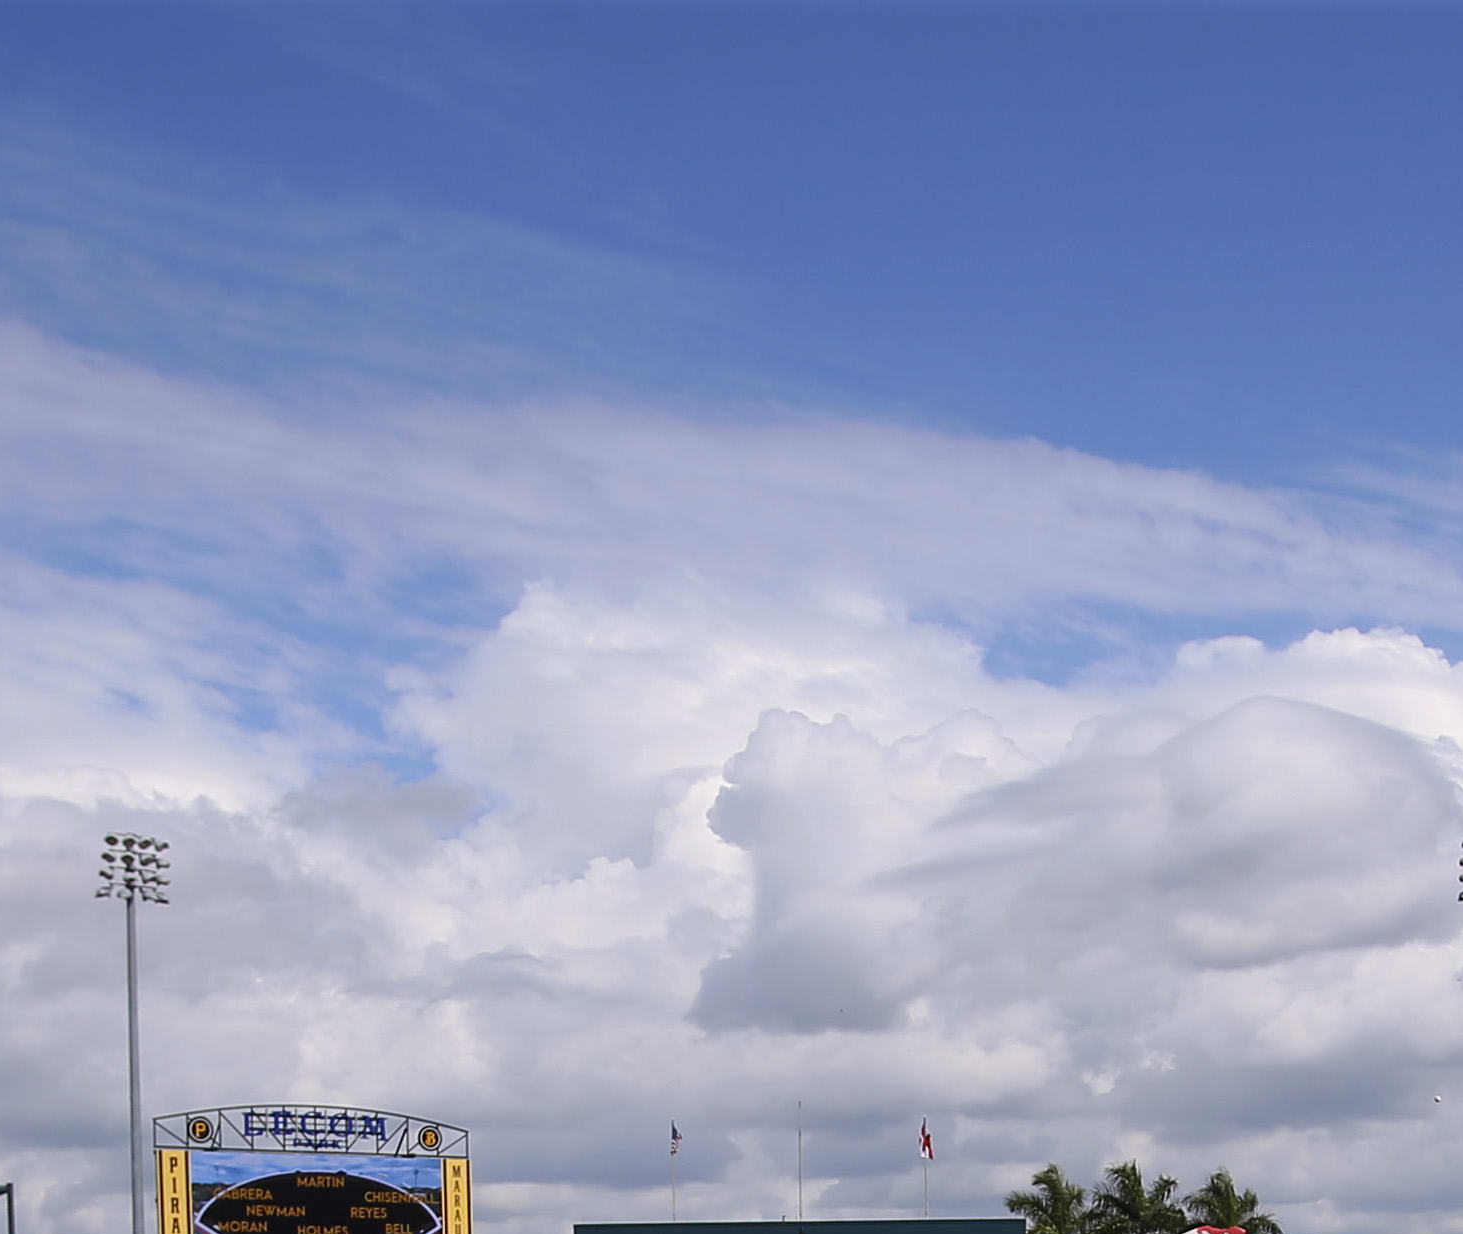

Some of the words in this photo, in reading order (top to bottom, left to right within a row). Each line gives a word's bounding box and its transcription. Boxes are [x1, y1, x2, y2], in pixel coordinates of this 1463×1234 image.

[195, 1121, 206, 1137] P
[242, 1111, 388, 1141] LECOM
[293, 1138, 342, 1149] PARK
[297, 1176, 345, 1188] MARTIN
[212, 1187, 274, 1201] CABRERA
[246, 1205, 306, 1217] NEWMAN
[350, 1207, 388, 1219] REYES
[218, 1220, 268, 1233] MORAN
[385, 1224, 413, 1234] BELL
